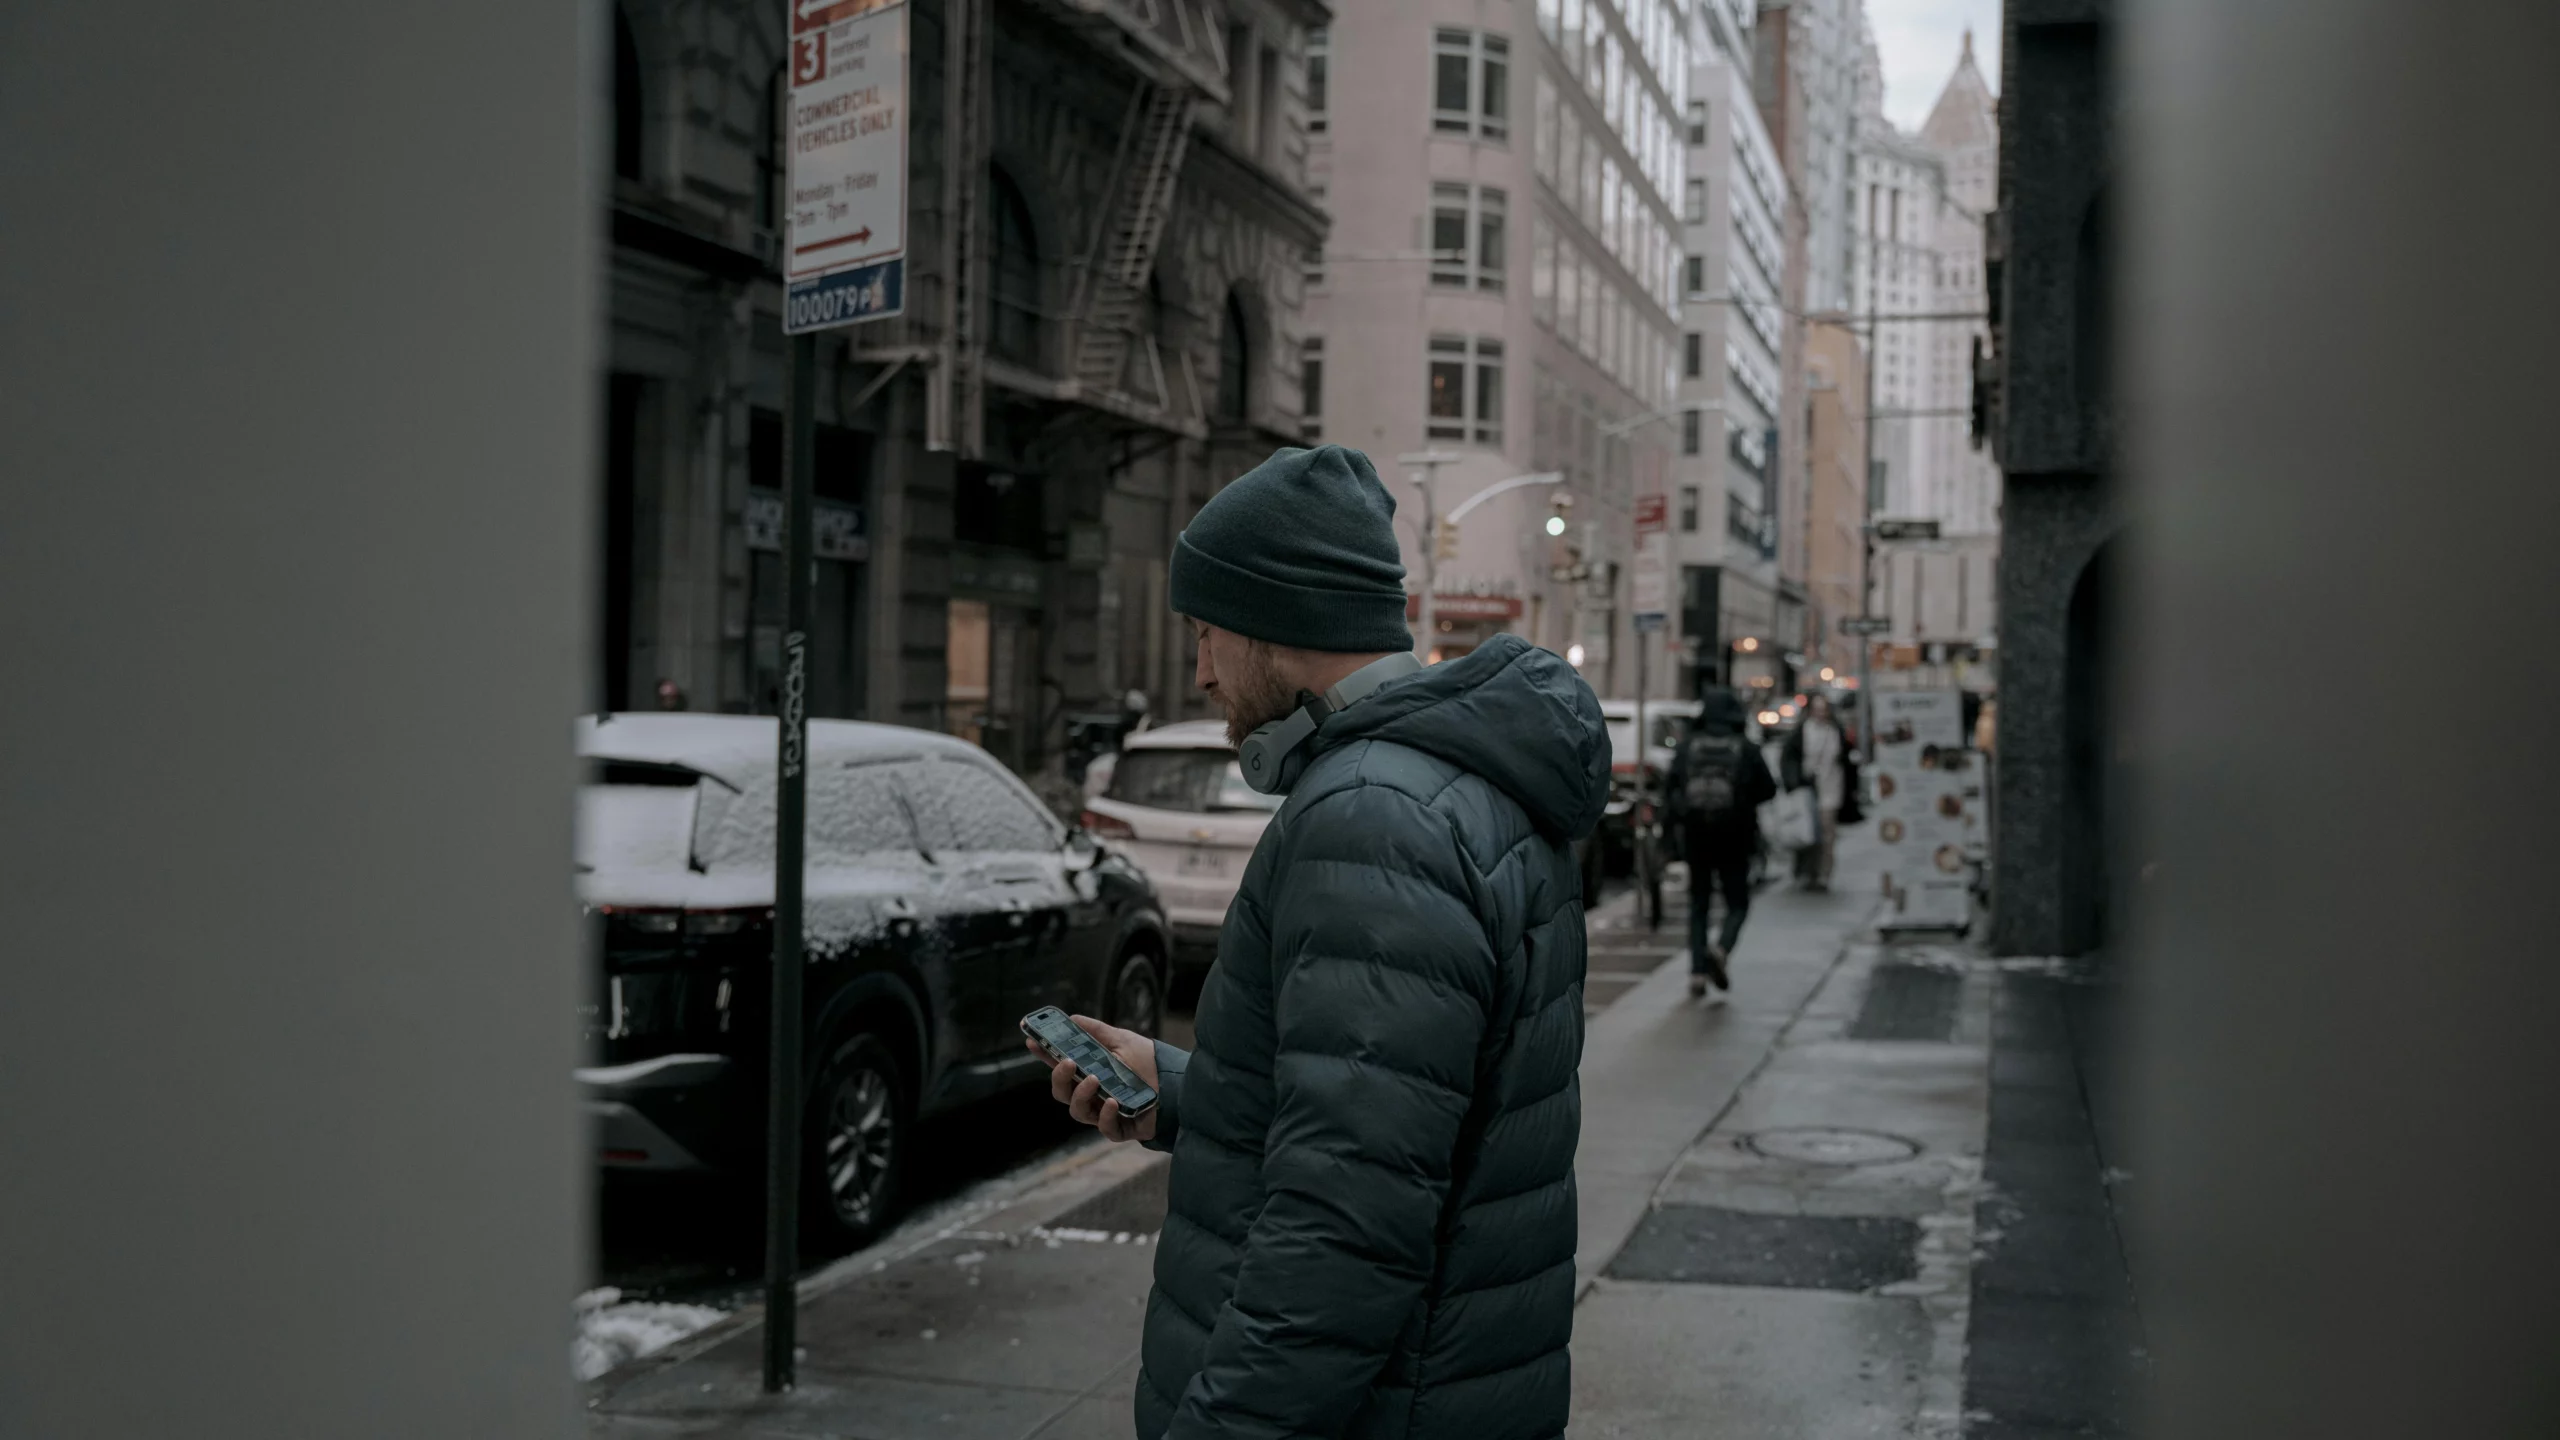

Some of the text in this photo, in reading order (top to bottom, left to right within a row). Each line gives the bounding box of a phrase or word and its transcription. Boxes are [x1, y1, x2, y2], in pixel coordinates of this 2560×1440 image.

[800, 31, 819, 81] 3
[798, 84, 880, 128] COMMERCIAL
[797, 107, 896, 153] VEHICLES ONLY
[796, 183, 834, 204] Monday
[845, 172, 879, 193] Friday
[796, 211, 815, 228] 7am
[826, 202, 849, 224] 7pm
